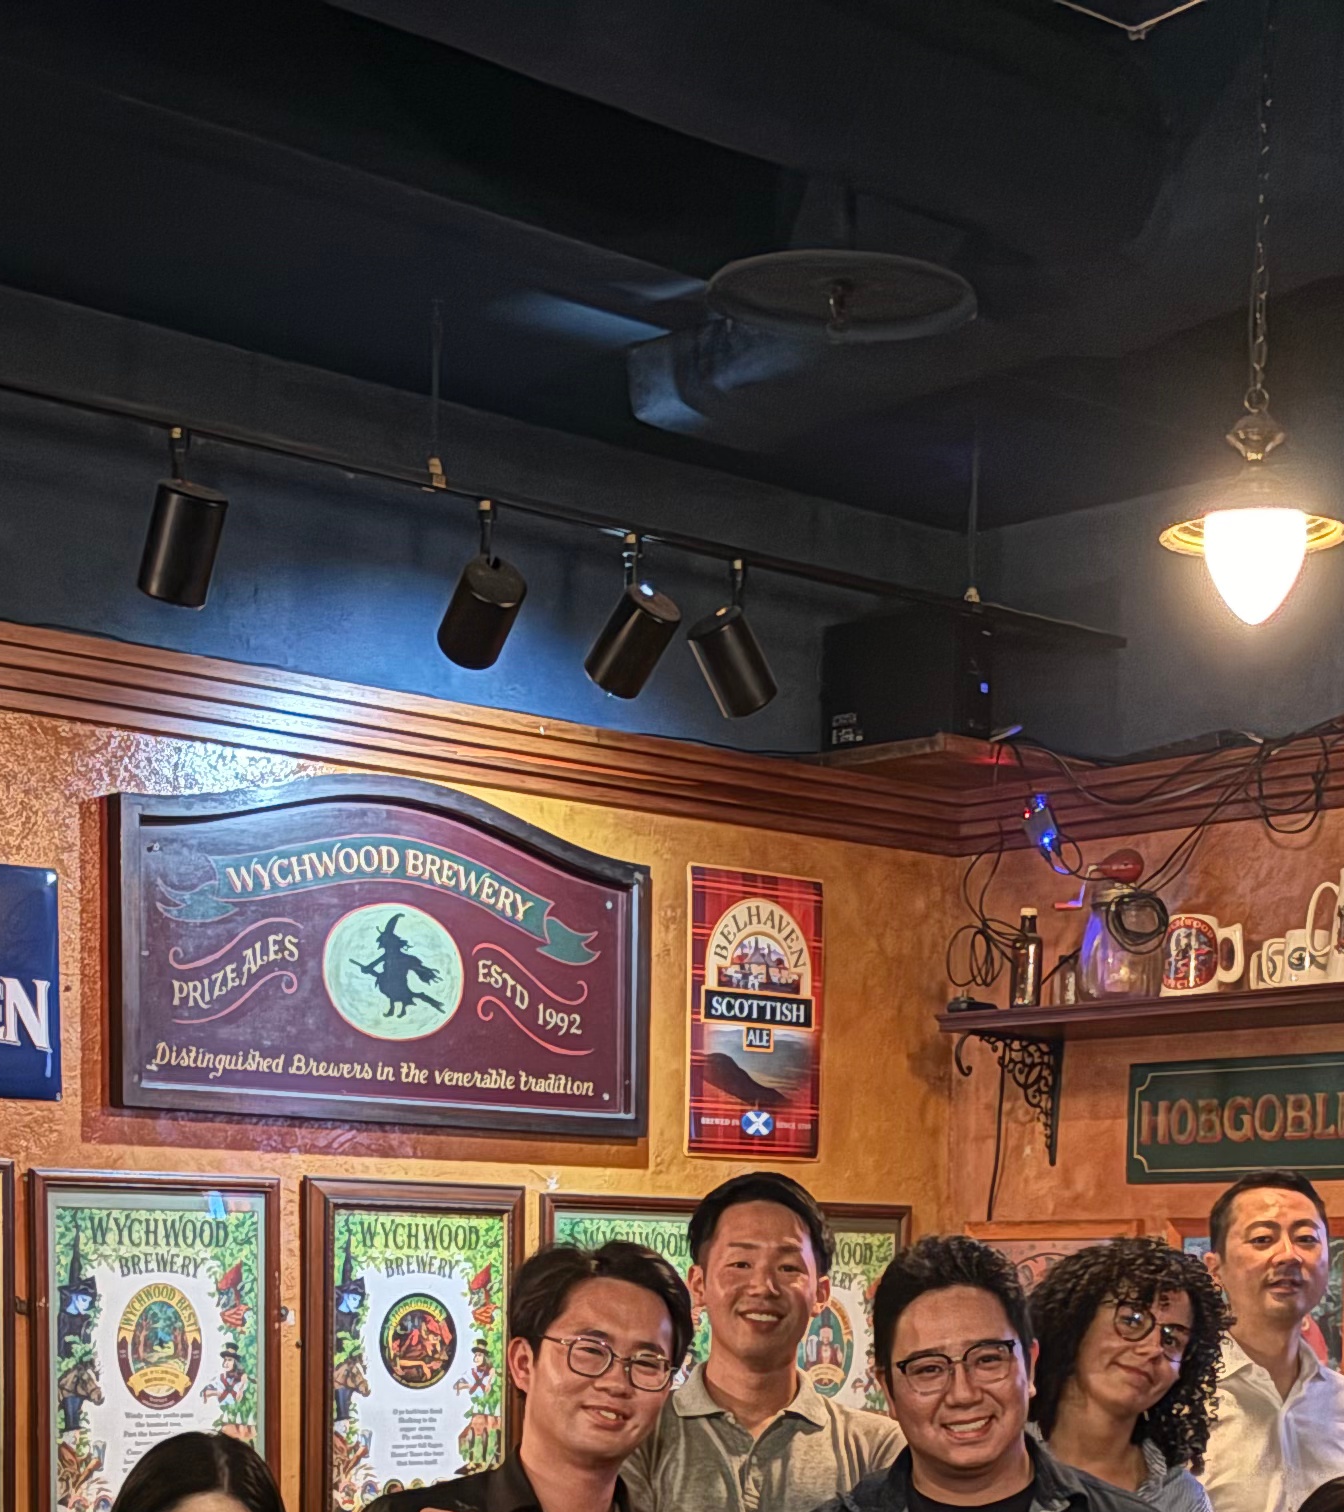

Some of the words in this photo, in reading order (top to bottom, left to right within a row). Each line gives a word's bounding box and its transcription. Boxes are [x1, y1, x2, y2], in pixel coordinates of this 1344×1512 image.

[226, 845, 399, 894] WYCHWOOD
[405, 849, 535, 924] BREWERY
[713, 904, 807, 969] BELHAVEN
[172, 966, 241, 1010] PRIZE
[241, 933, 300, 986] ALES
[477, 959, 531, 1011] ESTD
[536, 1006, 583, 1037] 1992
[711, 996, 805, 1023] SCOTTISH
[746, 1029, 770, 1047] ALE
[154, 1041, 285, 1079] Distinguished
[288, 1055, 372, 1081] Brewers
[376, 1058, 396, 1082] in
[400, 1062, 428, 1084] the
[434, 1066, 516, 1091] venerable
[519, 1070, 595, 1097] tradition
[89, 1213, 229, 1249] WYCHWOOD
[359, 1217, 481, 1250] WYCHWOOD
[119, 1251, 205, 1279] BREWERY
[384, 1253, 457, 1280] BREWERY
[123, 1285, 176, 1327] WYCHWOOD
[176, 1296, 199, 1330] BEST
